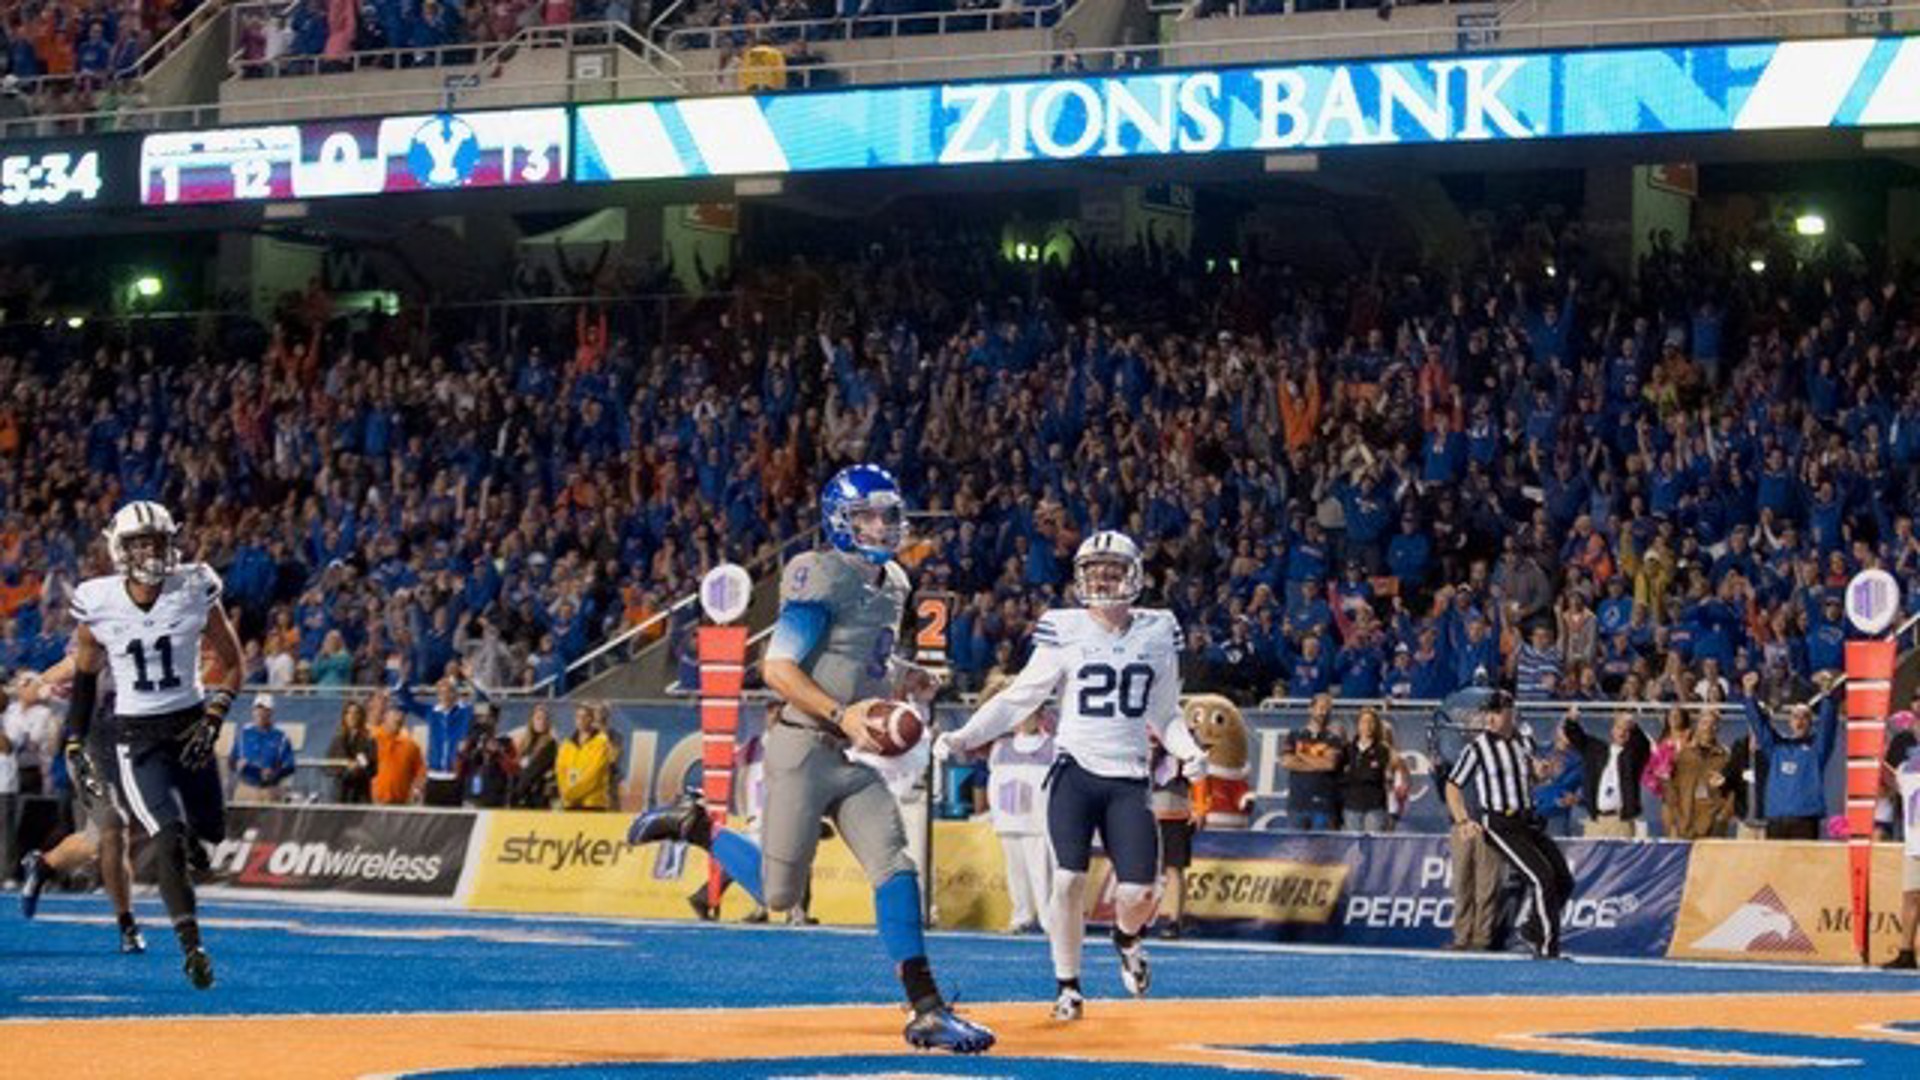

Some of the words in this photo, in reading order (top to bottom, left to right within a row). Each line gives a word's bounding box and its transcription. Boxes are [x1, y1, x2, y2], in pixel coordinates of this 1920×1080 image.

[939, 71, 1224, 163] ZIONS
[415, 117, 473, 184] Y
[519, 146, 550, 182] 3
[0, 151, 102, 205] 5:34
[161, 164, 180, 203] 1
[231, 160, 272, 199] 12
[916, 599, 947, 646] 2
[126, 633, 181, 692] 11
[1077, 662, 1155, 718] 20
[497, 830, 632, 871] stryker
[1187, 872, 1213, 900] ES
